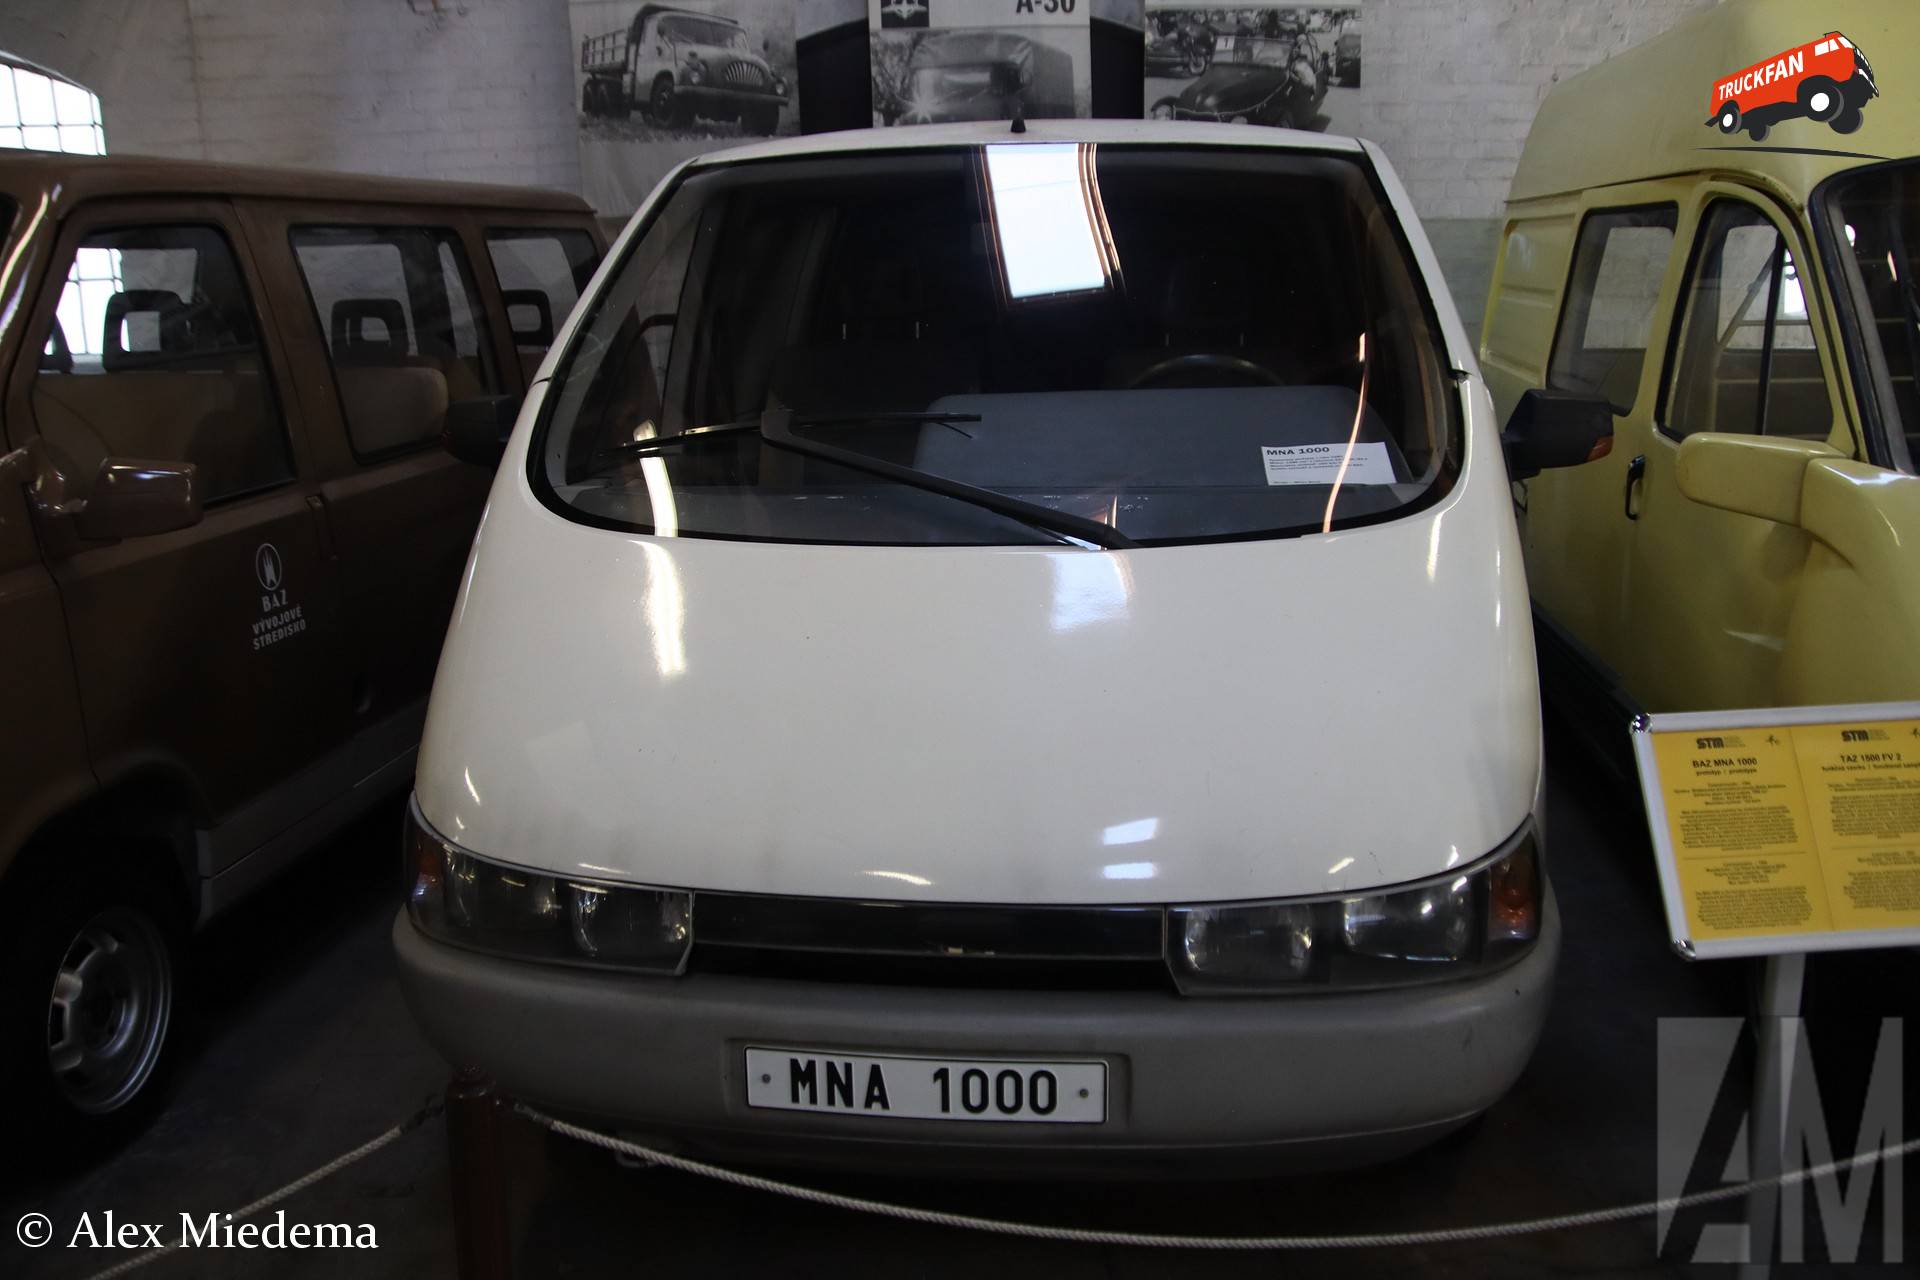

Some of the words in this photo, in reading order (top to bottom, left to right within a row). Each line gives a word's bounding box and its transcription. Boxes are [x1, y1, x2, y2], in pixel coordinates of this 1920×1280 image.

[262, 588, 288, 612] BAZ
[252, 619, 306, 650] STREDISKO
[1696, 737, 1724, 749] STM
[1841, 729, 1869, 742] STM
[1713, 758, 1735, 767] MNA
[1737, 757, 1757, 766] 1000
[790, 1058, 890, 1110] MNA
[933, 1067, 1057, 1115] 1000
